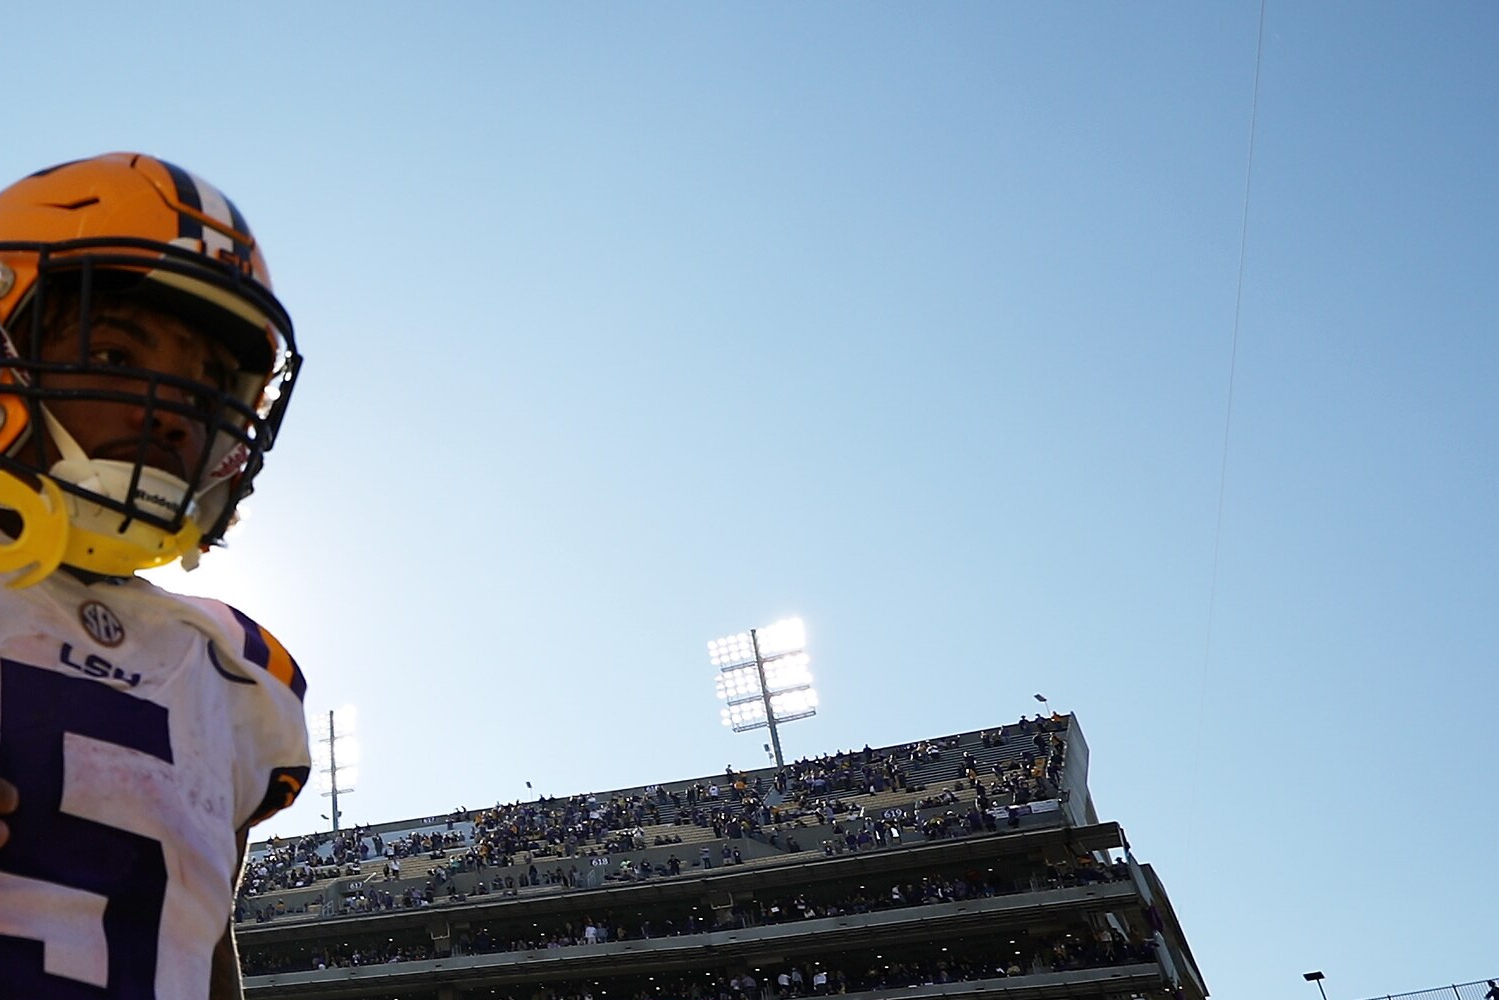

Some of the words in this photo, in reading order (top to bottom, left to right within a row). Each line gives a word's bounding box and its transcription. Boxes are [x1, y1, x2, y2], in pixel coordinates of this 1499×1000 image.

[59, 641, 141, 688] LSU
[884, 808, 903, 818] 619
[591, 857, 609, 867] 618
[349, 881, 363, 890] 617
